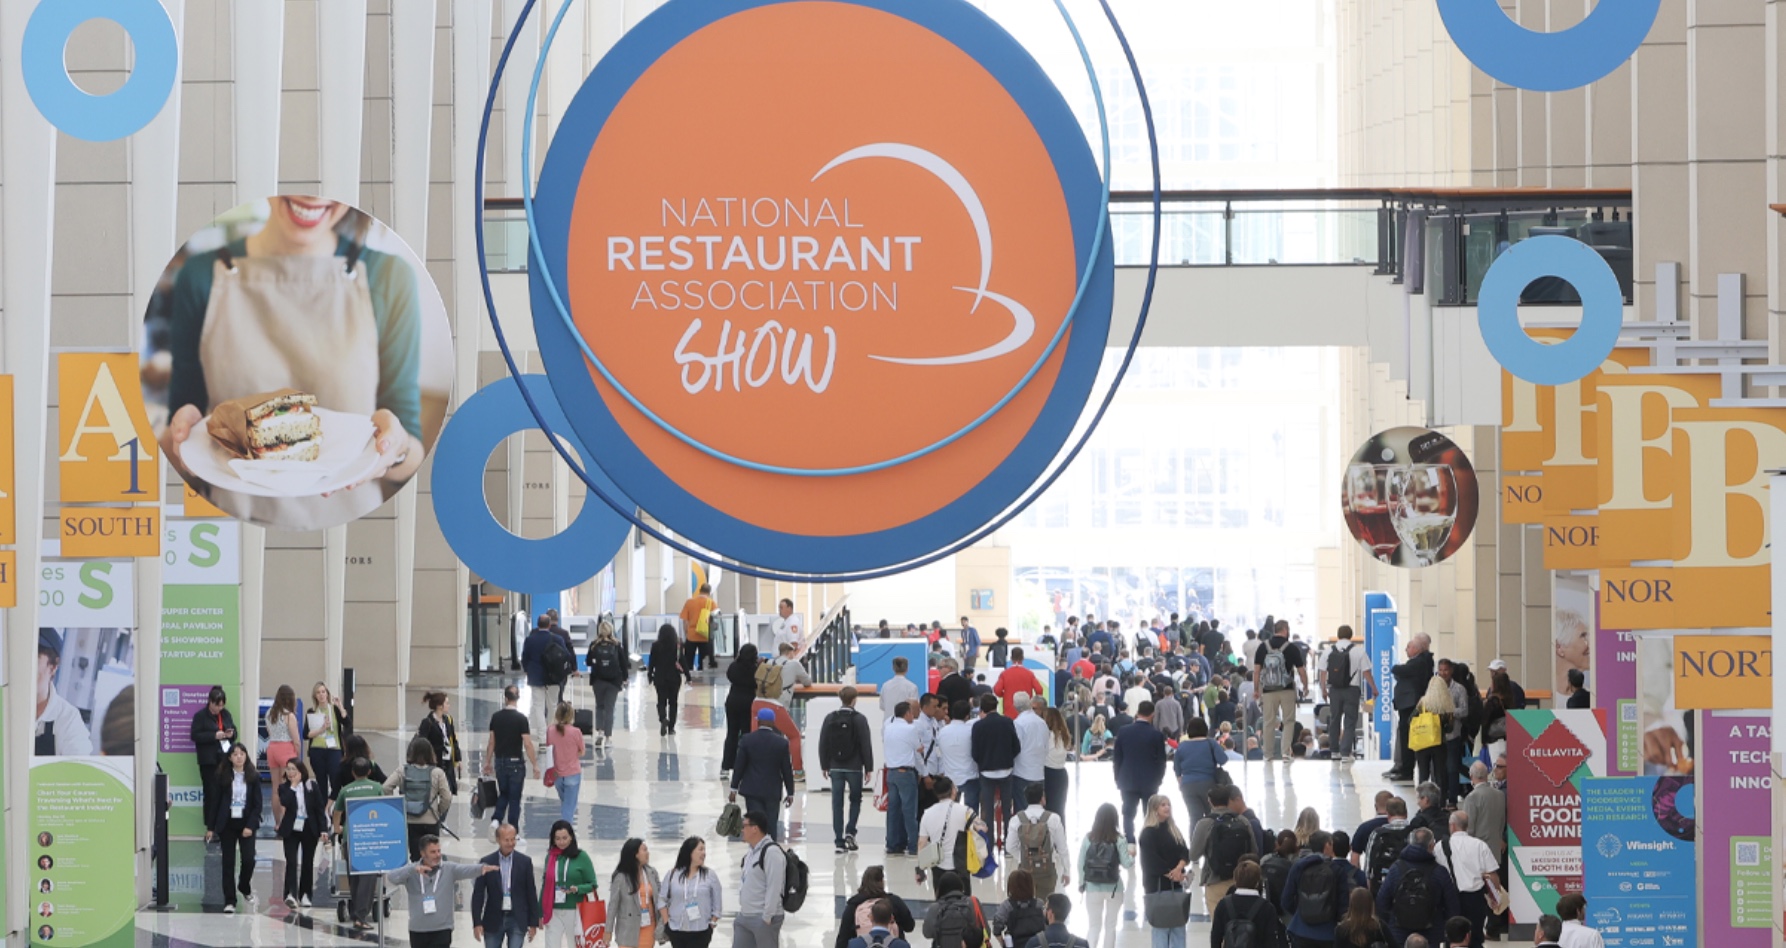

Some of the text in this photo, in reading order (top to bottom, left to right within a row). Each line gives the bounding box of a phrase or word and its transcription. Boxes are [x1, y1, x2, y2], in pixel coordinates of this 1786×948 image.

[661, 197, 864, 227] NATIONAL
[607, 235, 922, 272] RESTAURANT
[631, 280, 898, 311] ASSOCIATION
[673, 317, 837, 394] SHOW
[59, 361, 153, 461] A
[118, 437, 148, 494] 1
[1506, 484, 1543, 504] NO
[65, 516, 153, 536] SOUTH
[187, 522, 221, 568] S
[77, 561, 114, 609] S
[1604, 579, 1674, 603] NOR
[190, 607, 224, 615] CENTER
[183, 622, 224, 630] PAVILION
[171, 636, 224, 644] SHOWROOM
[1381, 649, 1391, 722] BOOKSTORE
[1729, 724, 1743, 738] A
[1529, 748, 1584, 757] BELLAVITA
[1729, 750, 1772, 764] TECH
[1730, 776, 1773, 789] INNO
[1529, 794, 1582, 807] ITALIAN
[1586, 796, 1643, 804] FOODSERVICE
[1529, 808, 1582, 823] FOOD
[1586, 805, 1615, 813] MEDIA,
[1586, 813, 1648, 821] AND RESEARCH
[1531, 864, 1562, 872] BOOTH
